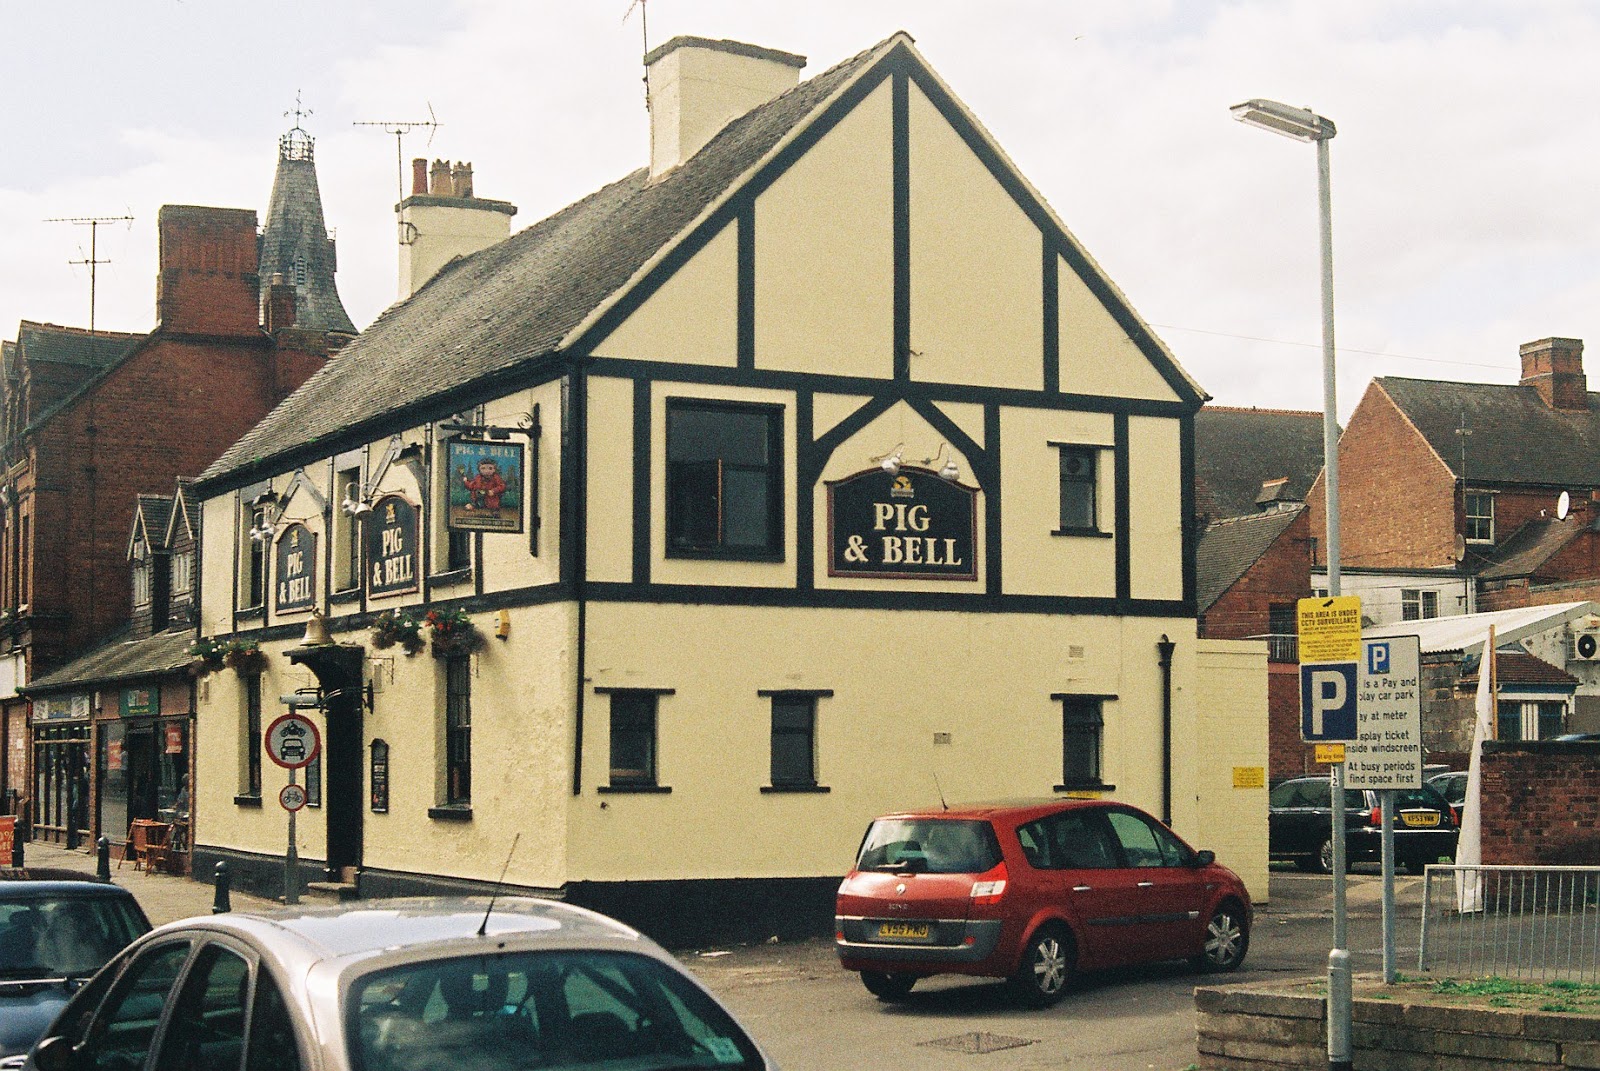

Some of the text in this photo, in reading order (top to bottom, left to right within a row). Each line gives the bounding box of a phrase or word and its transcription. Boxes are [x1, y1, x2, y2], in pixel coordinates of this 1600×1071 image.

[455, 444, 474, 455] PIG
[490, 447, 516, 458] BELL
[873, 502, 931, 531] PIG
[382, 527, 403, 557] PIG
[844, 535, 962, 566] & BELL
[287, 550, 303, 578] PIG
[373, 554, 414, 587] & BELL
[279, 575, 311, 604] & BELL
[1338, 609, 1357, 617] UNDER
[1301, 617, 1357, 627] CCTV SURVEILLANCE
[1373, 646, 1386, 671] P
[1363, 676, 1417, 689] is a Pay and
[1378, 691, 1391, 701] car
[1395, 690, 1414, 701] park
[1311, 670, 1347, 735] P
[1359, 711, 1407, 722] ay at meter
[1360, 730, 1410, 742] splay ticket
[1371, 743, 1419, 753] windscreen
[1348, 760, 1415, 773] At busy periods
[1349, 773, 1414, 785] find space first
